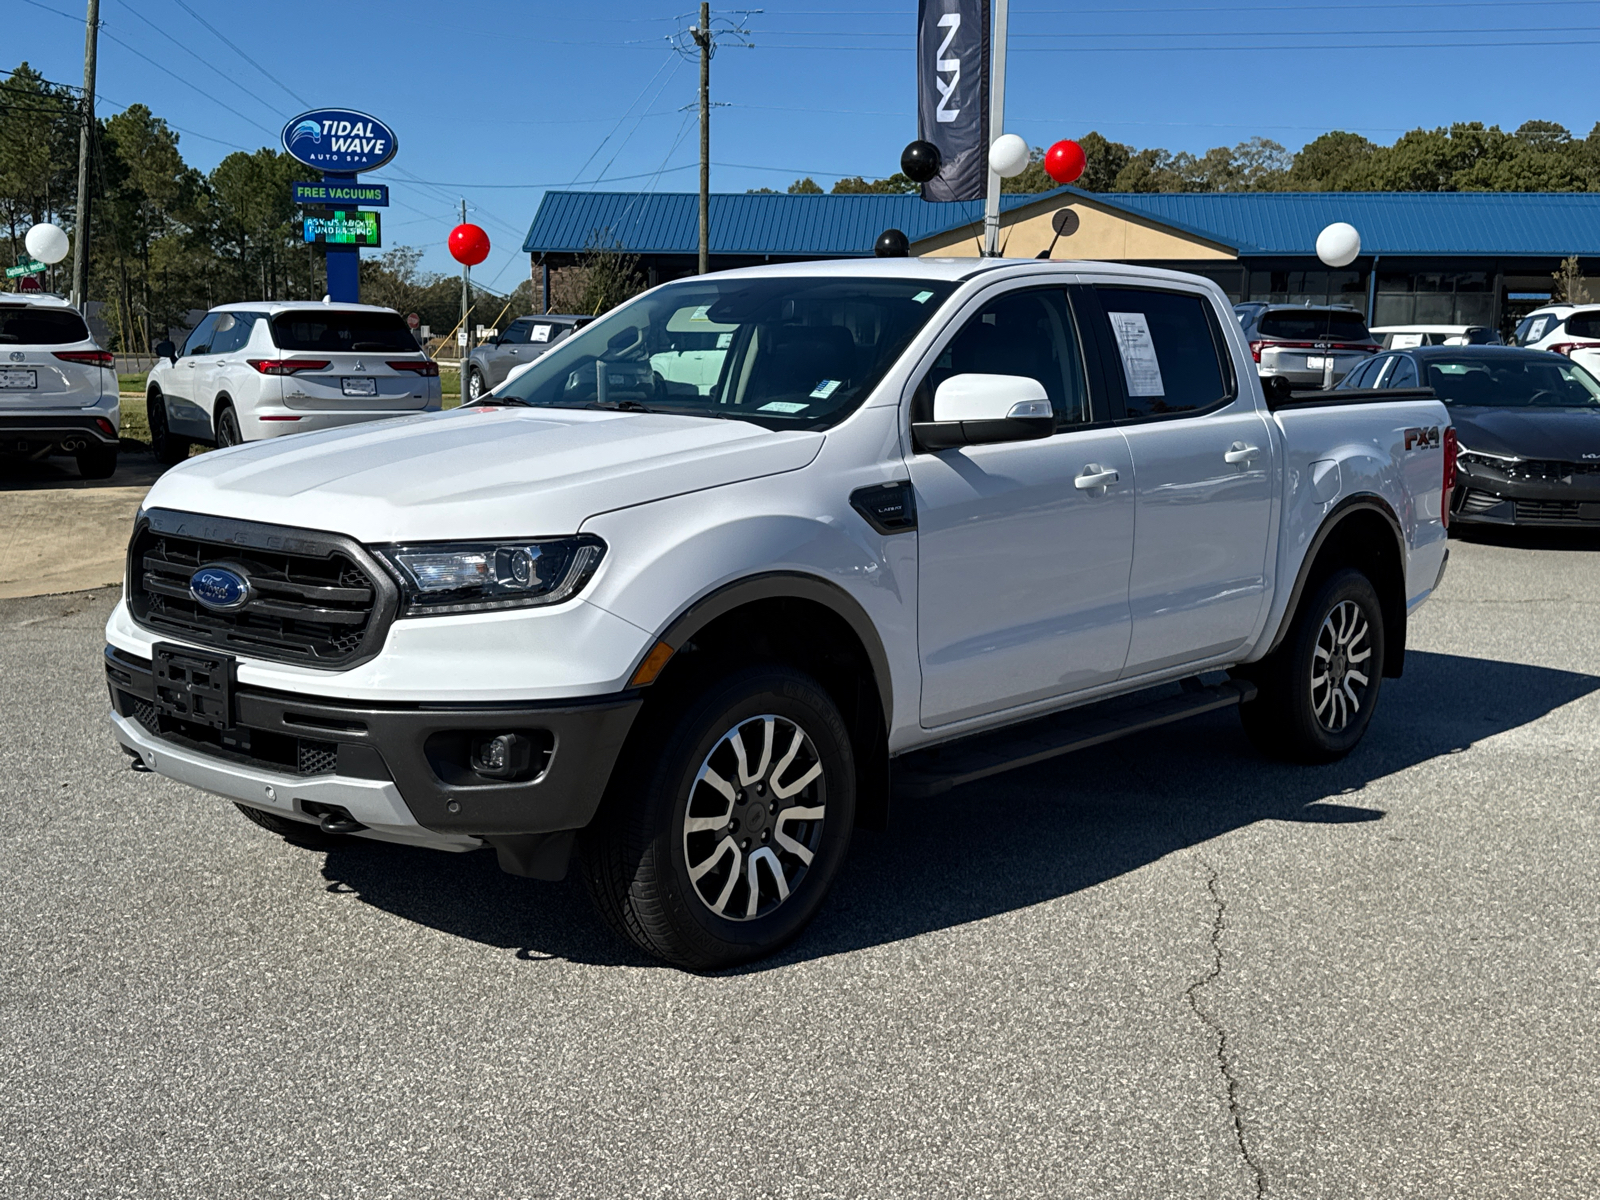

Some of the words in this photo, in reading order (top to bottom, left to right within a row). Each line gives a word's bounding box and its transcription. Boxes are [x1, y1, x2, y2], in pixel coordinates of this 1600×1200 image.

[323, 120, 374, 137] TIDAL
[331, 138, 385, 154] WAVE
[310, 153, 338, 161] AUTO
[346, 155, 367, 163] SPA
[297, 187, 326, 198] FREE
[329, 188, 382, 200] VACUUMS
[308, 218, 325, 226] ASK
[1404, 426, 1440, 451] FX4
[151, 518, 317, 551] RANGER
[199, 573, 229, 600] Ford
